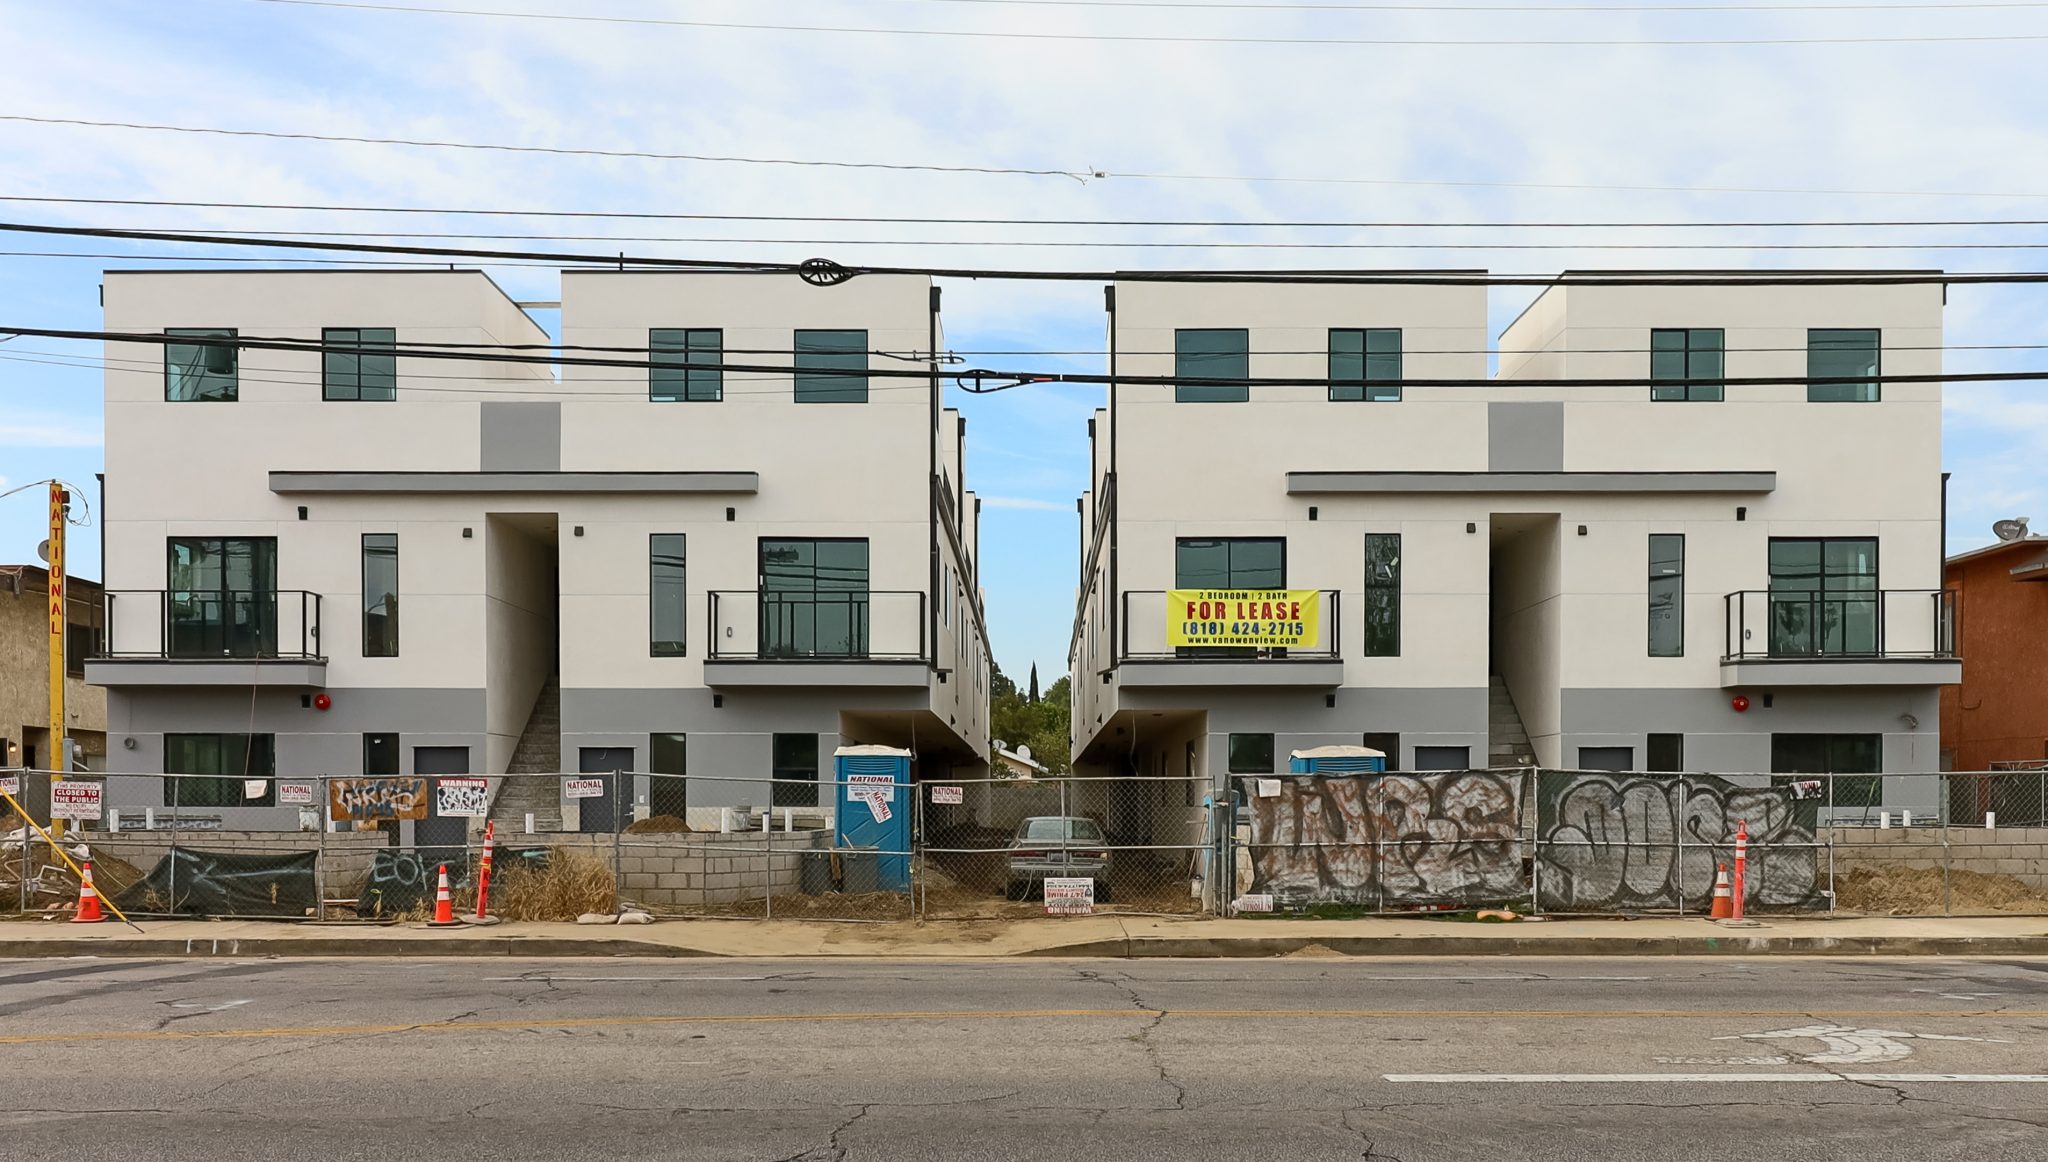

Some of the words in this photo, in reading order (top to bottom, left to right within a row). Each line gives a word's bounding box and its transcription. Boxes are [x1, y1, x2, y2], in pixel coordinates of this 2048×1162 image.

[51, 490, 61, 635] NATIONAL
[1207, 592, 1248, 600] BEDROOM
[1266, 592, 1288, 600] BATH
[1187, 601, 1226, 620] FOR
[1237, 602, 1300, 621] LEASE
[1183, 622, 1225, 635] (818)
[1231, 622, 1303, 636] 424-2715
[1187, 636, 1298, 645] www.vanowenview.com
[439, 779, 485, 787] WARNING
[567, 780, 602, 789] NATIONAL
[281, 785, 311, 795] NATIONAL
[933, 787, 962, 796] NATIONAL
[71, 796, 99, 804] PUBLIC
[873, 791, 892, 819] NATIONAL
